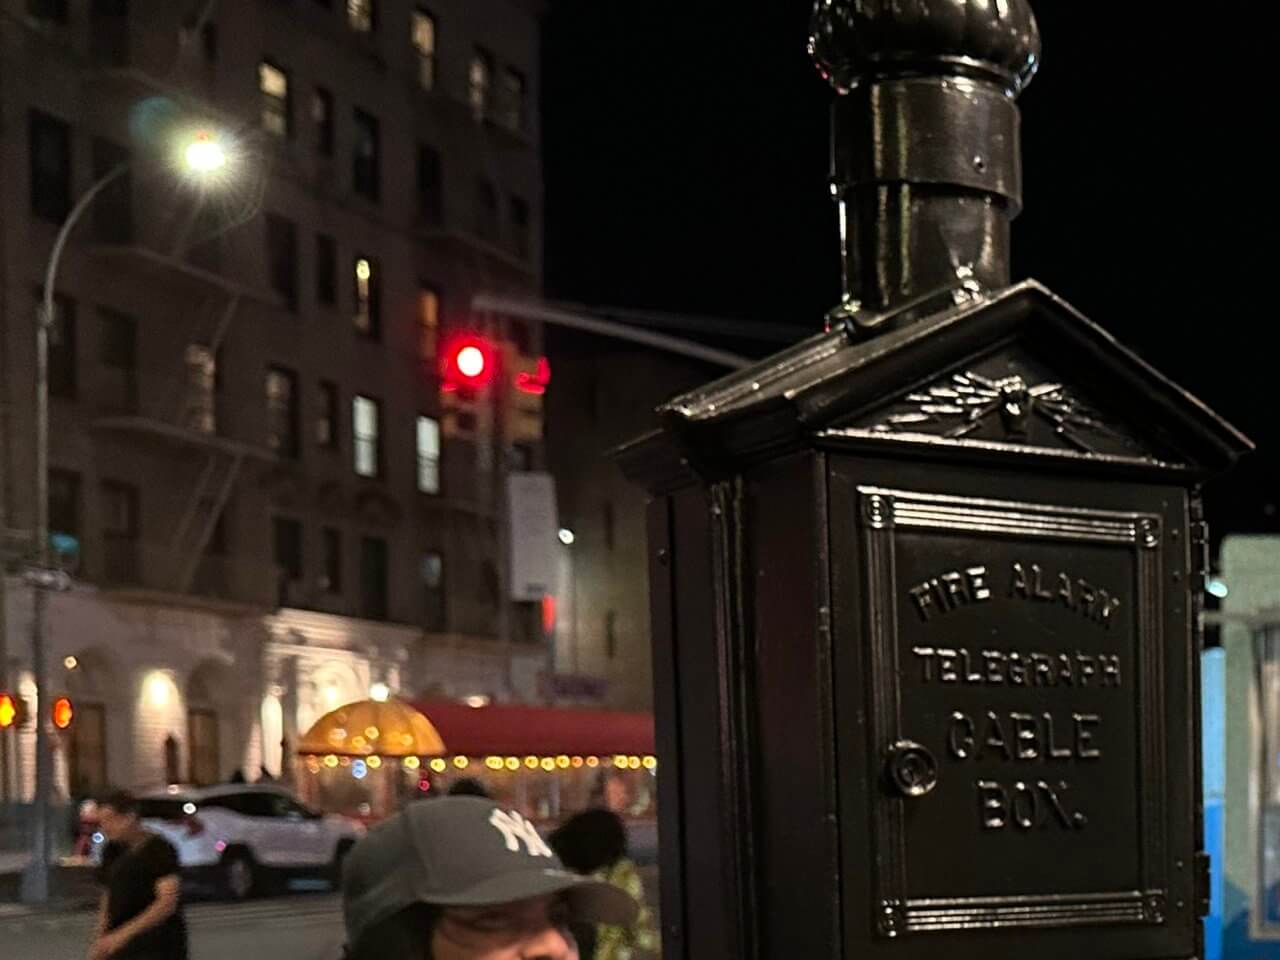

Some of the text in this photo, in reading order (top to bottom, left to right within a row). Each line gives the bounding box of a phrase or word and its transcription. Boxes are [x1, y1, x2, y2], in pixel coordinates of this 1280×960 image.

[909, 562, 1120, 628] FIRE ALARM
[912, 646, 1121, 687] TELEGRAPH
